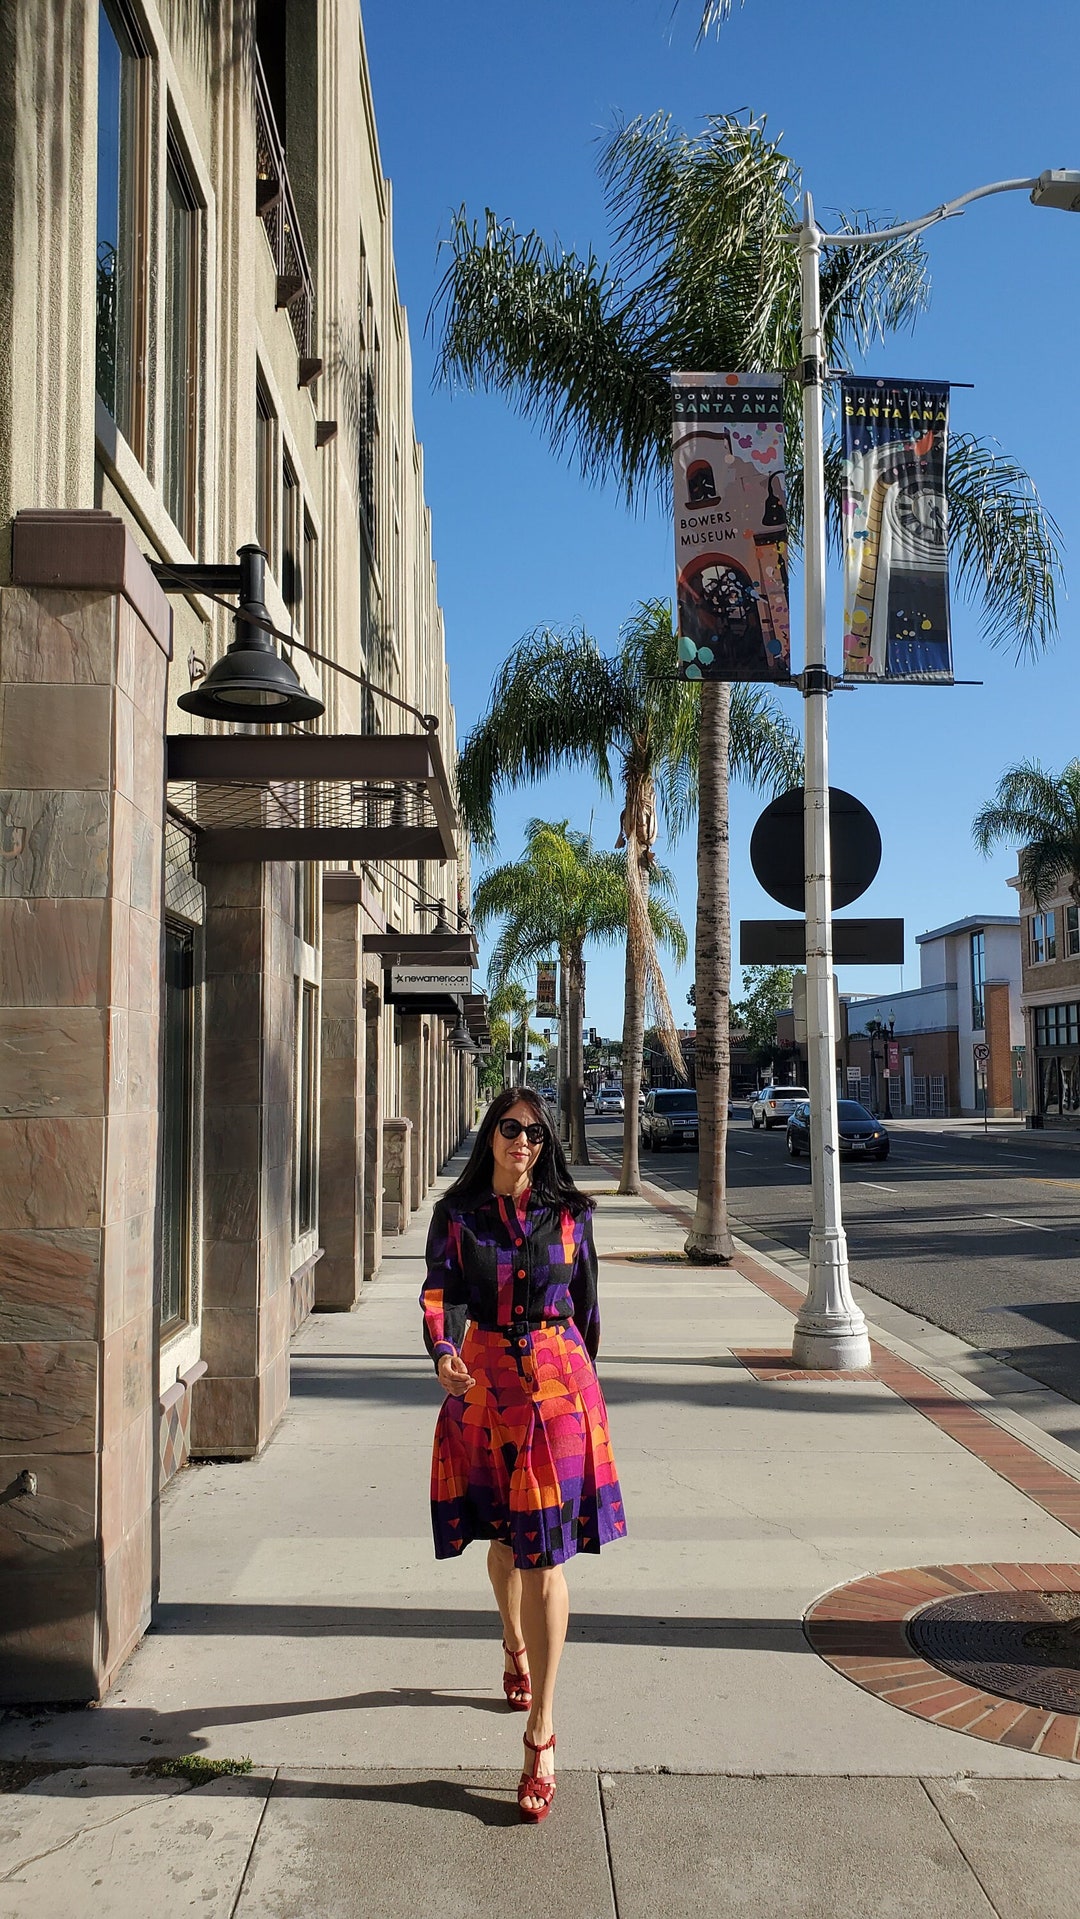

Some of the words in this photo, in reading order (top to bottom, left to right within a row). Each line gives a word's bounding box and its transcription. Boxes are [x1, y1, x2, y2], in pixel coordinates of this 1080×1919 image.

[674, 393, 778, 401] DOWNTOWN
[845, 396, 946, 409] DOWNTOWN
[675, 403, 734, 413] SANTA
[741, 403, 779, 414] ANA
[845, 405, 903, 419] SANTA
[909, 409, 947, 421] ANA
[680, 511, 732, 529] BOWERS
[681, 528, 736, 546] MUSEUM
[404, 975, 469, 983] newamerican
